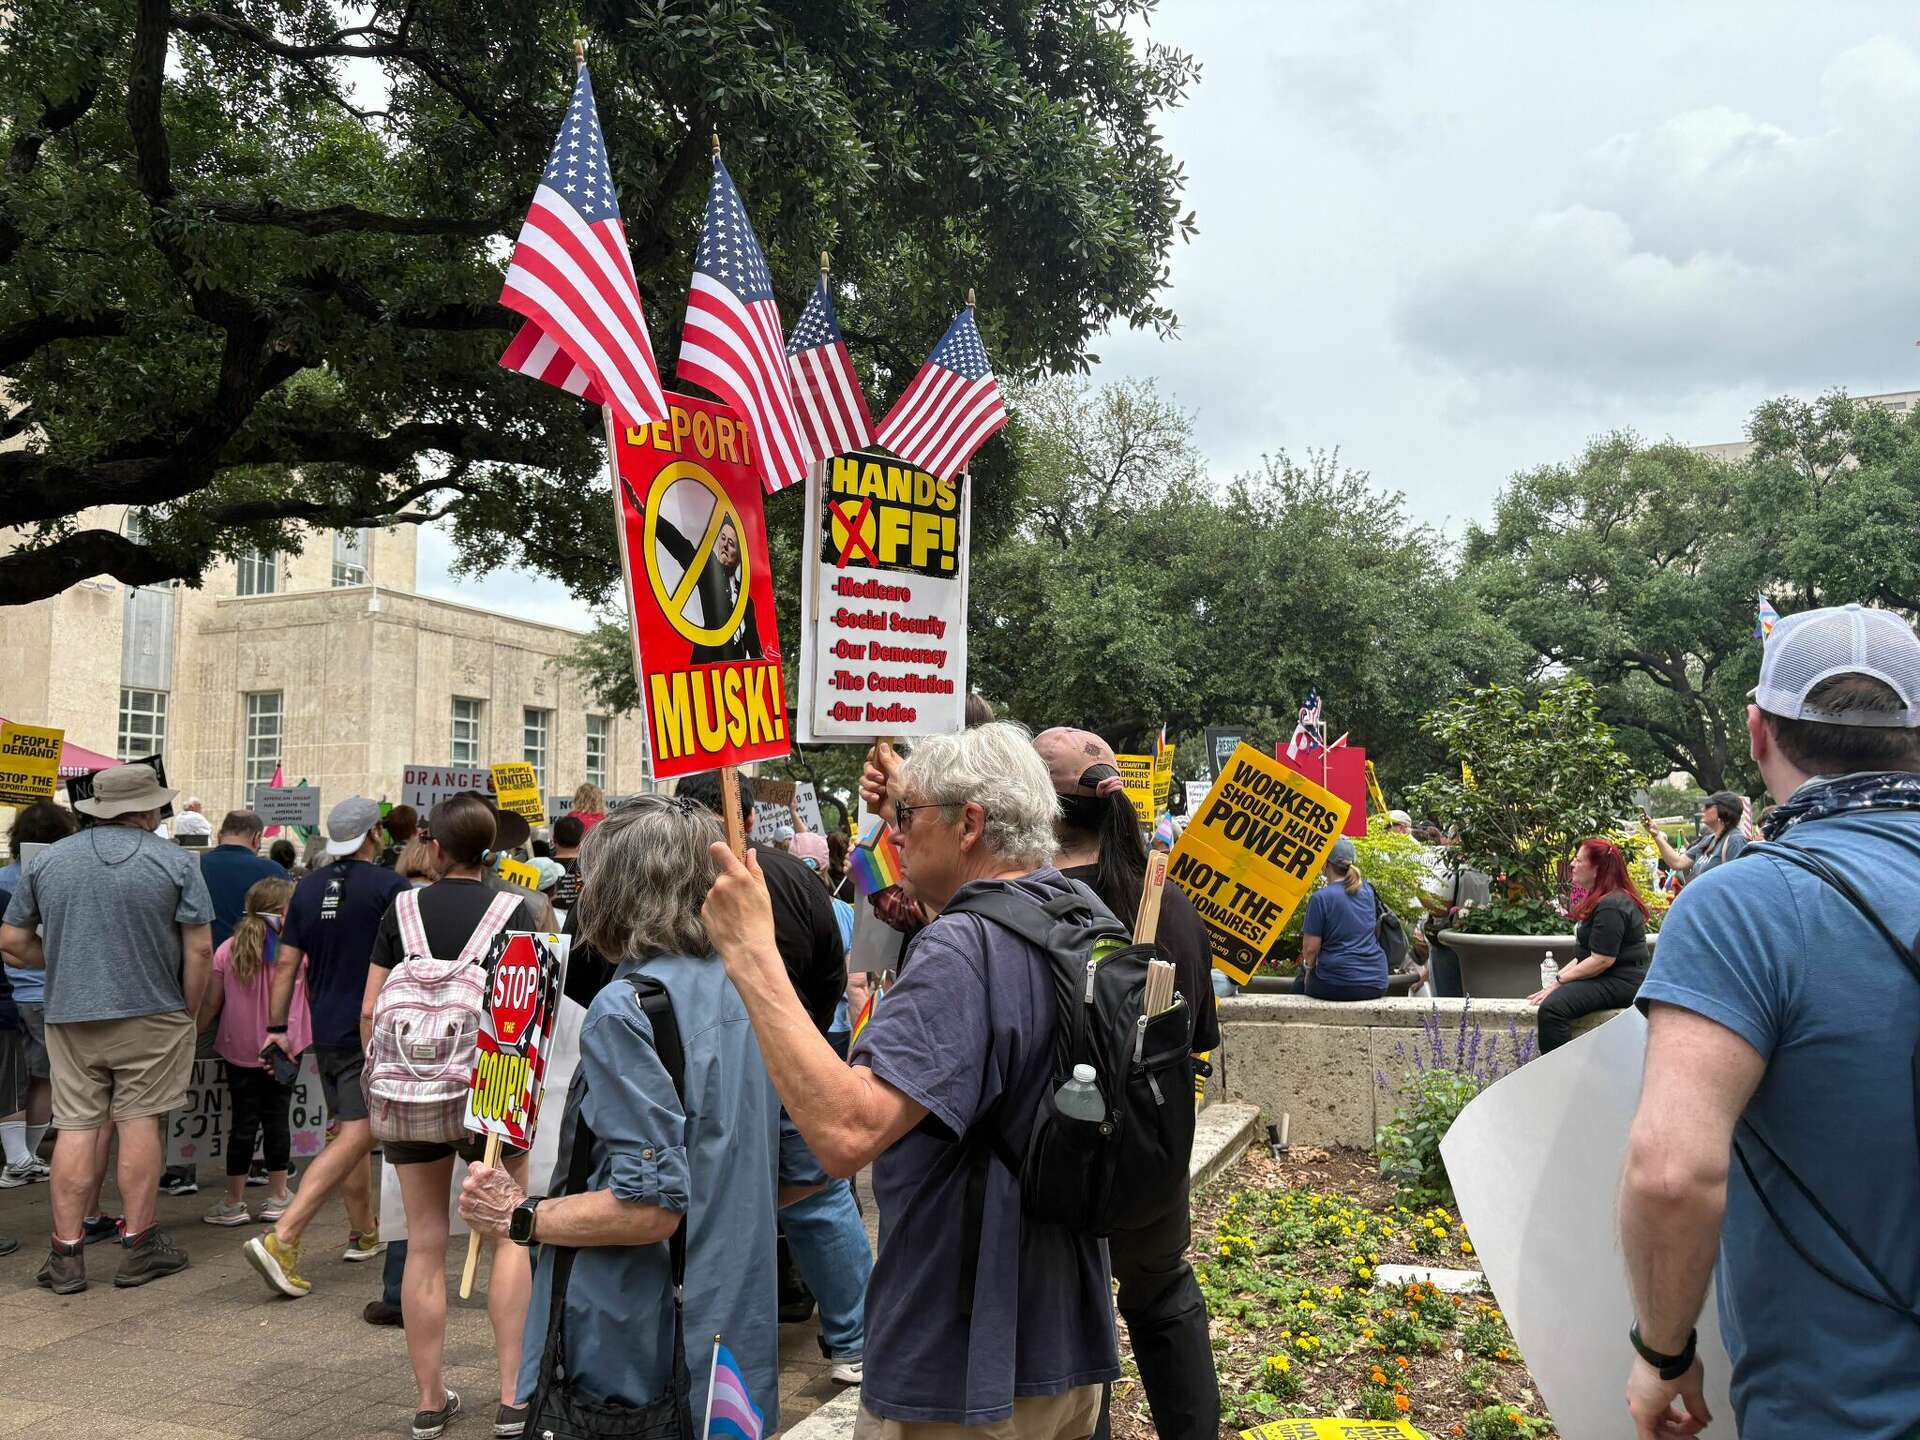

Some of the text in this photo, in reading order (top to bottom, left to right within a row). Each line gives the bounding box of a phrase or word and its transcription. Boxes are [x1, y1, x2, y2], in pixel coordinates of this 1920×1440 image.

[832, 457, 956, 511] HANDS
[830, 500, 956, 570] OFF!
[831, 576, 911, 602] -Medicare
[831, 607, 946, 639] -Social Security
[830, 639, 947, 668] -Our Democracy
[828, 670, 954, 694] -The Constitution
[650, 665, 785, 761] MUSK!
[827, 701, 917, 722] -Our bodies
[2, 744, 58, 760] DEMAND:
[13, 734, 60, 750] PEOPLE
[0, 772, 53, 787] STOP THE
[405, 771, 482, 788] ORANGE
[497, 774, 533, 785] UNITED
[508, 766, 530, 774] PEOPLE
[1121, 770, 1150, 778] ORKERS'
[803, 792, 813, 802] TO
[1232, 760, 1338, 834] WORKERS
[1220, 783, 1328, 853] SHOULD HAVE
[1202, 798, 1316, 881] POWER
[1170, 852, 1230, 898] NOT
[1228, 882, 1284, 931] THE
[494, 965, 537, 1010] STOP
[503, 1021, 515, 1034] THE
[472, 1051, 531, 1125] COUP!!
